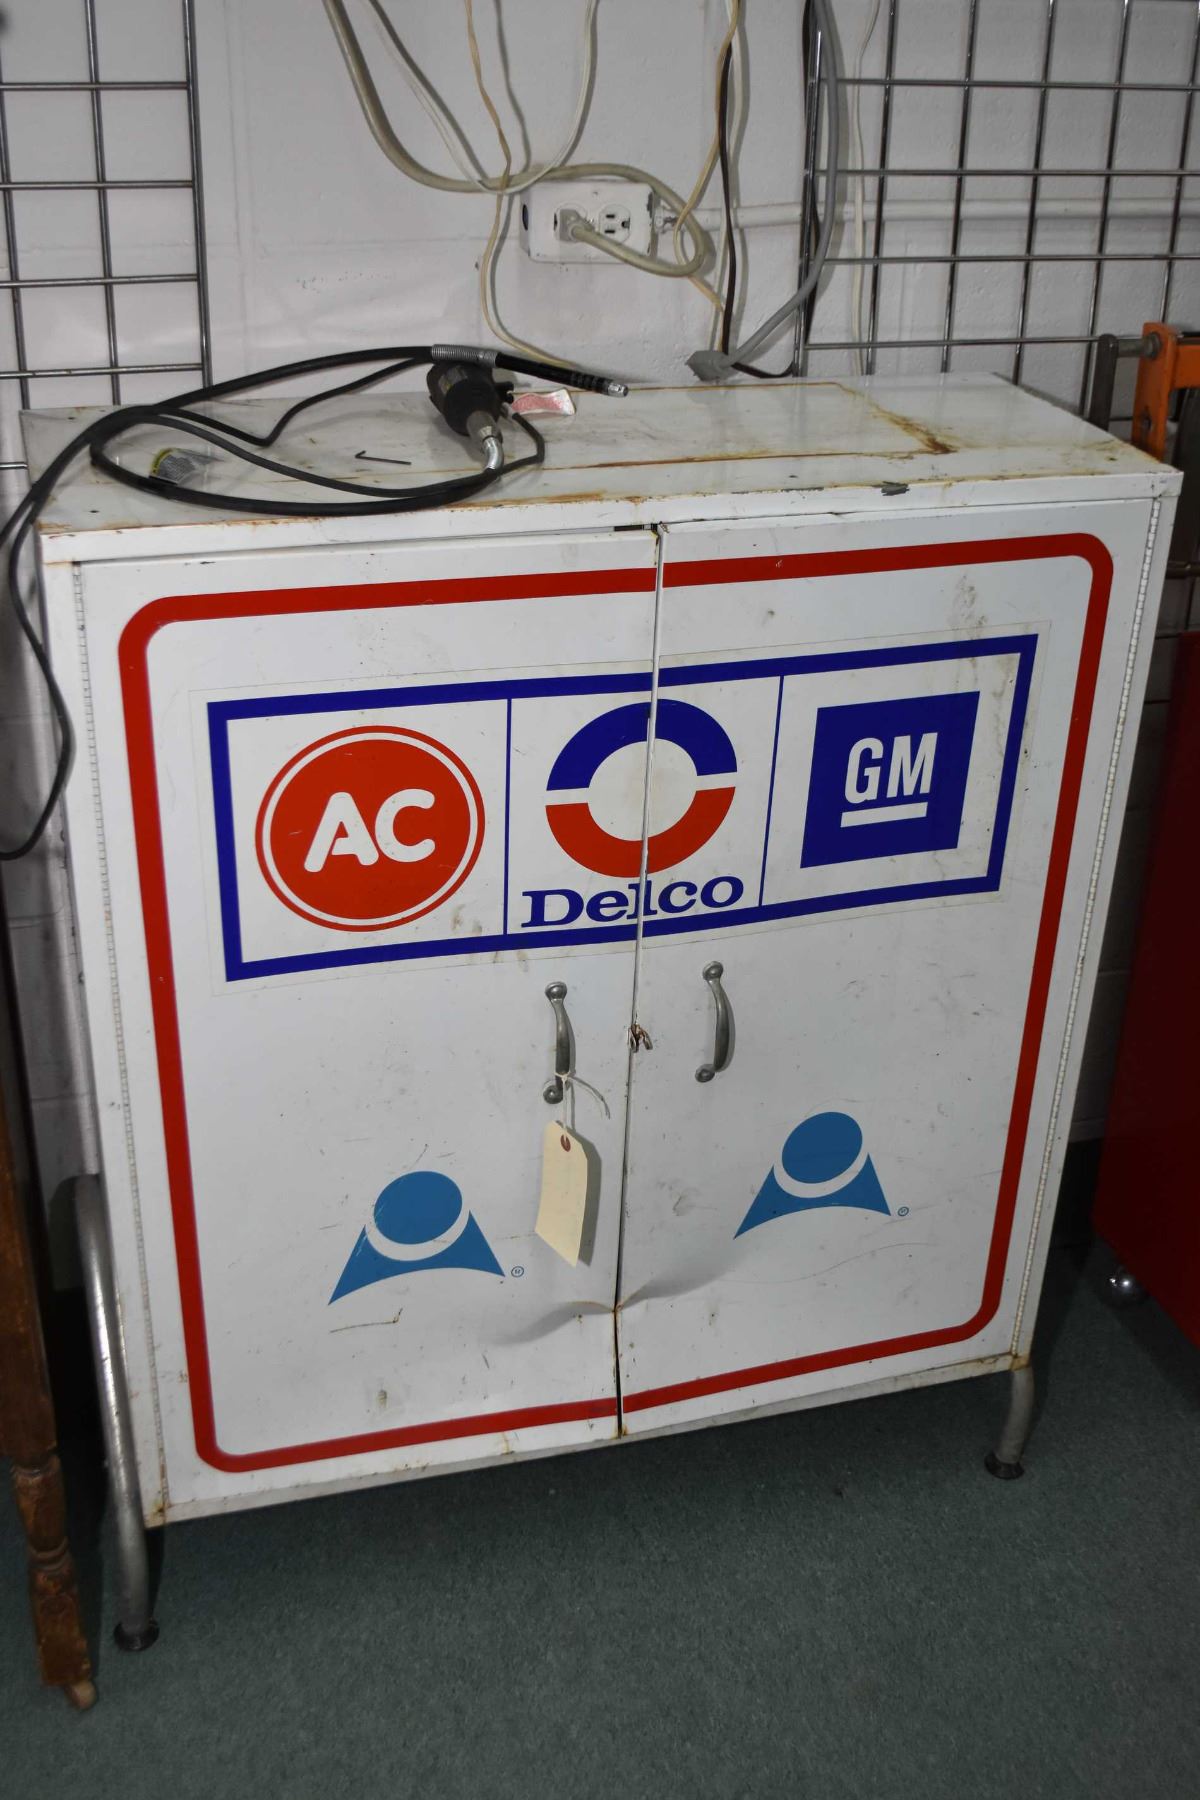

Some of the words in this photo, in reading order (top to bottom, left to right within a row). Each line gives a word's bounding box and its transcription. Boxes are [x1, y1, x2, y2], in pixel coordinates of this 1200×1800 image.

[844, 732, 938, 804] GM
[304, 788, 435, 873] AC
[521, 876, 744, 927] Delco
